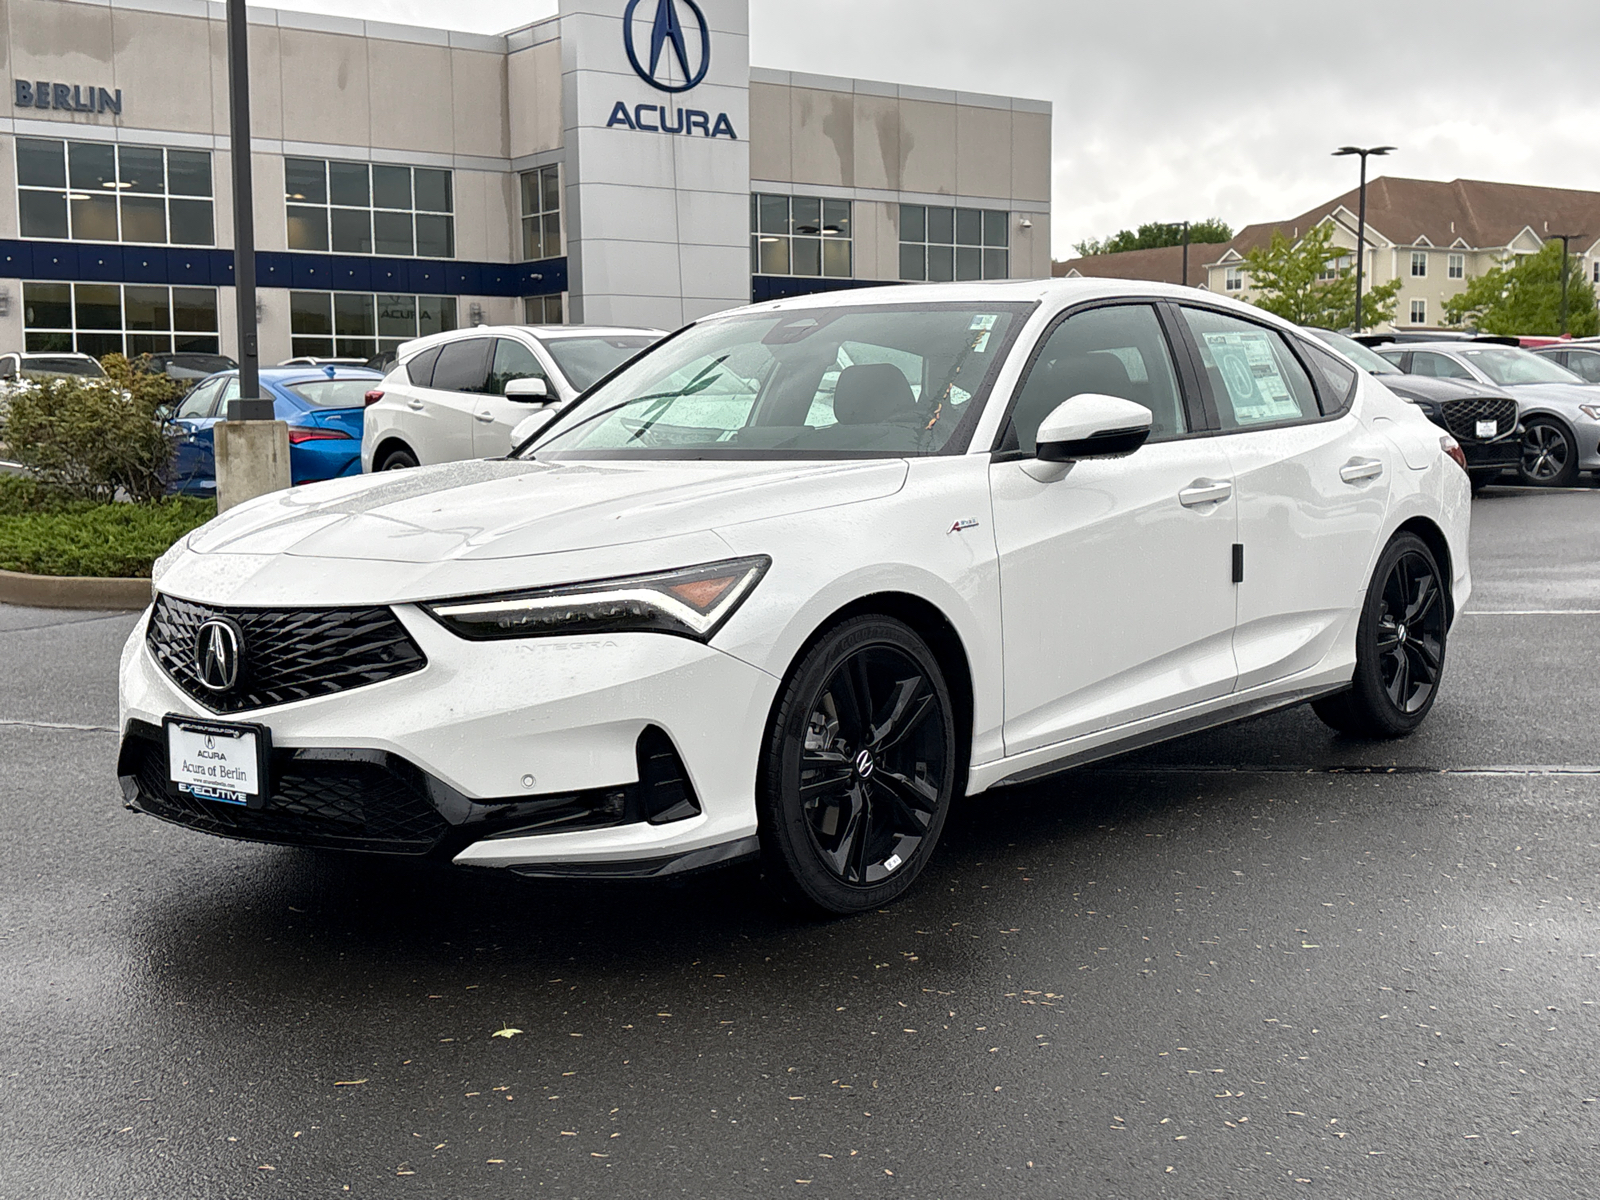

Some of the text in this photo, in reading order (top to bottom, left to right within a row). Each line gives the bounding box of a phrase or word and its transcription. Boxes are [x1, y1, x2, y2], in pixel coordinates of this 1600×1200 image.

[15, 79, 122, 115] BERLIN
[606, 101, 737, 139] ACURA
[515, 641, 618, 653] INTEGRA
[197, 749, 227, 761] ACURA
[182, 760, 247, 781] Acura of Berlin
[178, 782, 247, 802] EXECUTIVE
